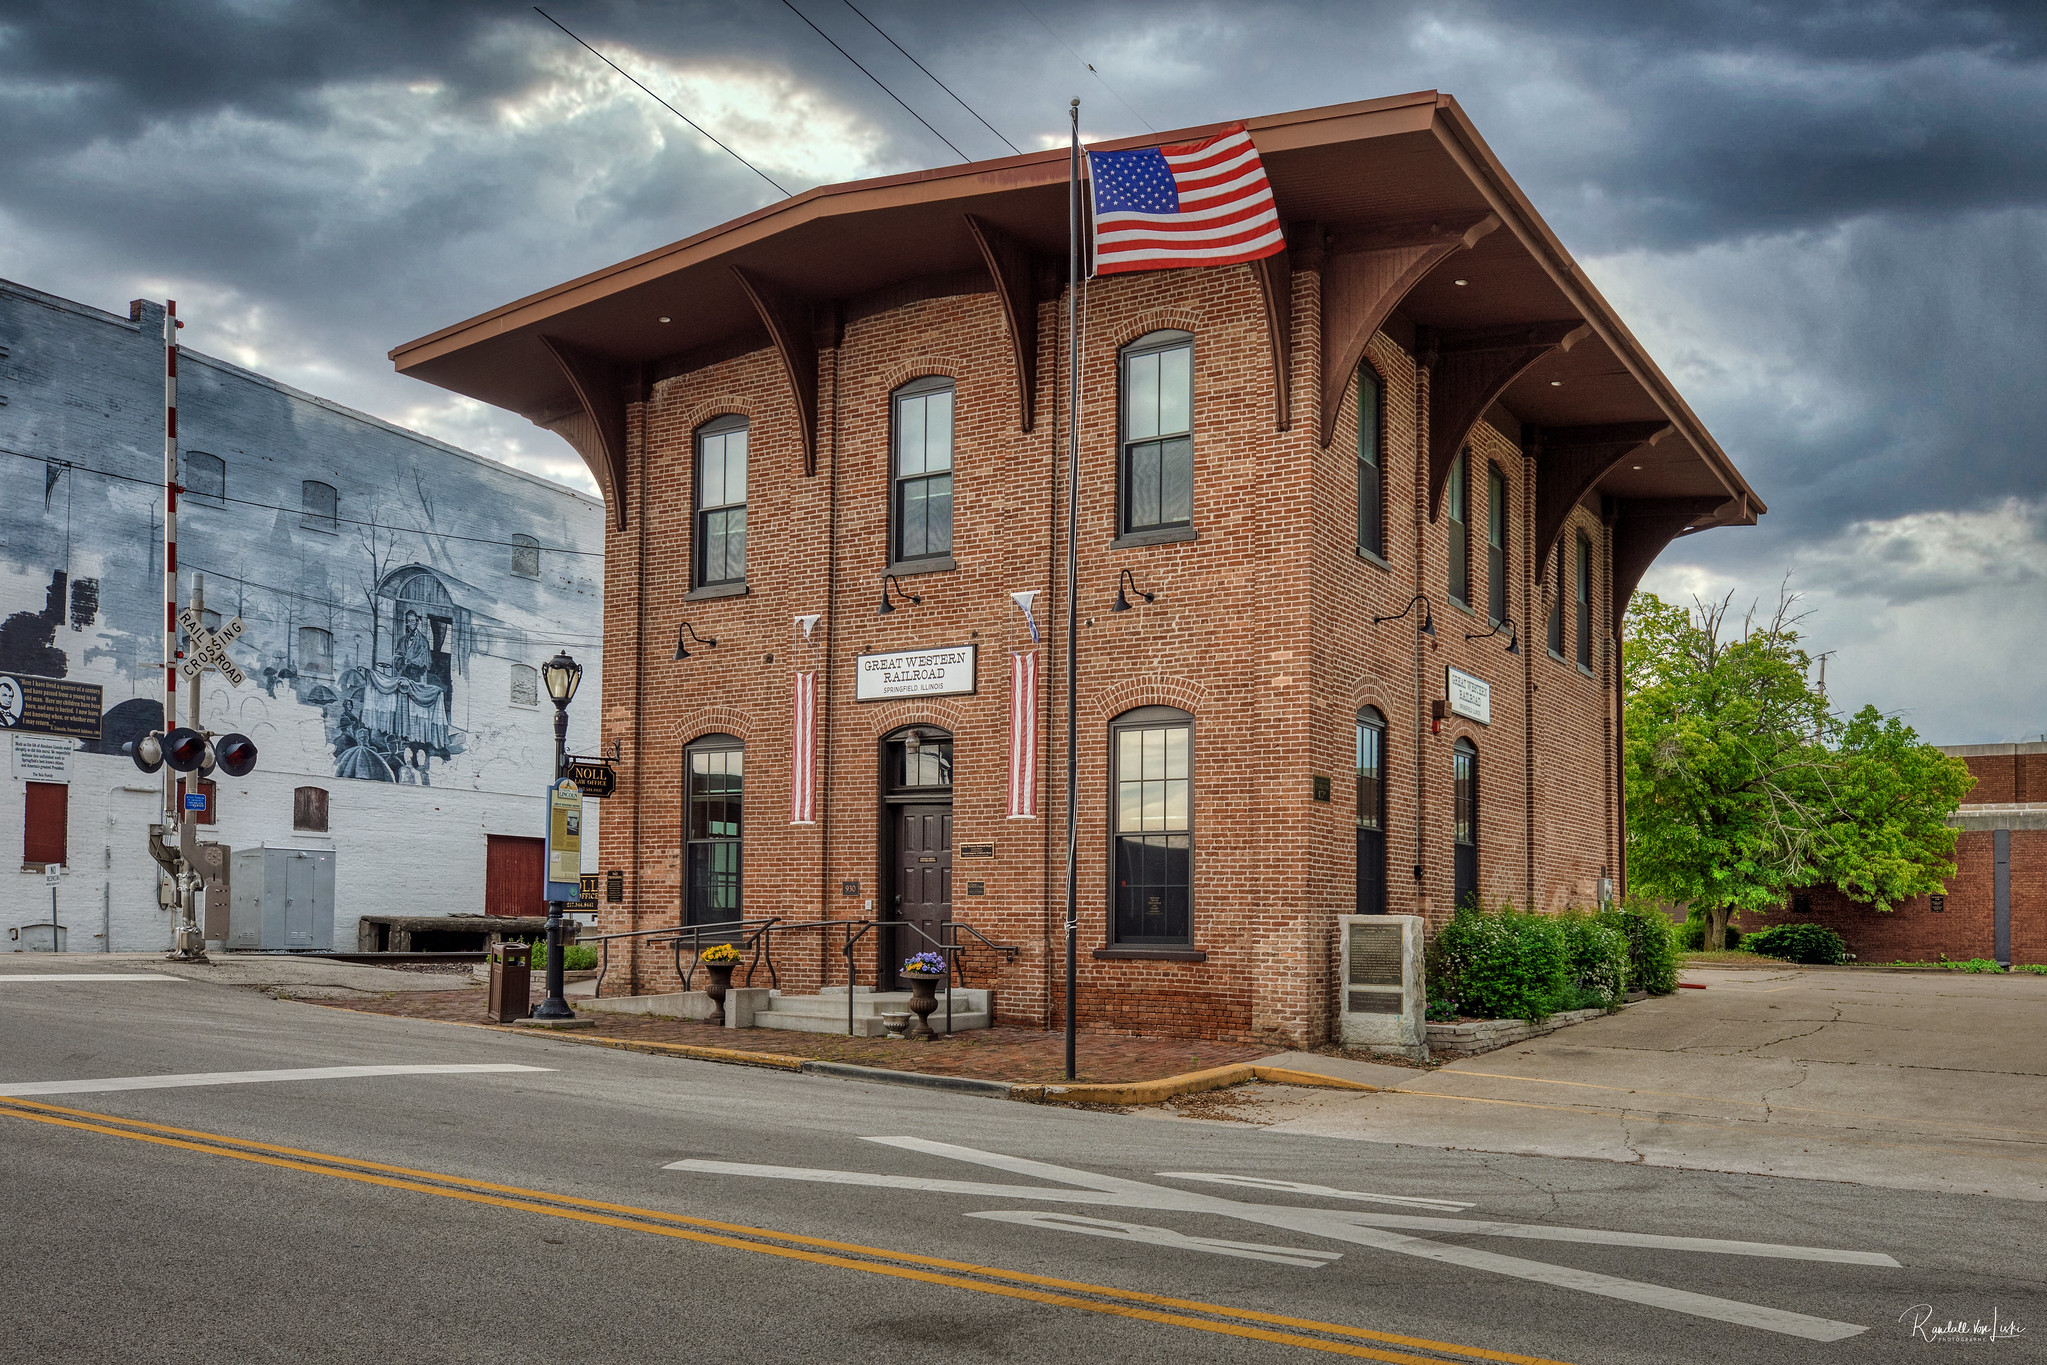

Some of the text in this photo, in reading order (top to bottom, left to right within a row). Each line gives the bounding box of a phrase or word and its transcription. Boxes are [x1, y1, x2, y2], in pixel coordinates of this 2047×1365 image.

[180, 612, 204, 643] RAIL
[184, 622, 242, 676] CROSSING
[216, 654, 242, 684] ROAD
[864, 652, 966, 671] GREAT WESTERN
[883, 668, 945, 683] RAILROAD
[575, 768, 606, 780] NOLL
[580, 880, 598, 892] LL
